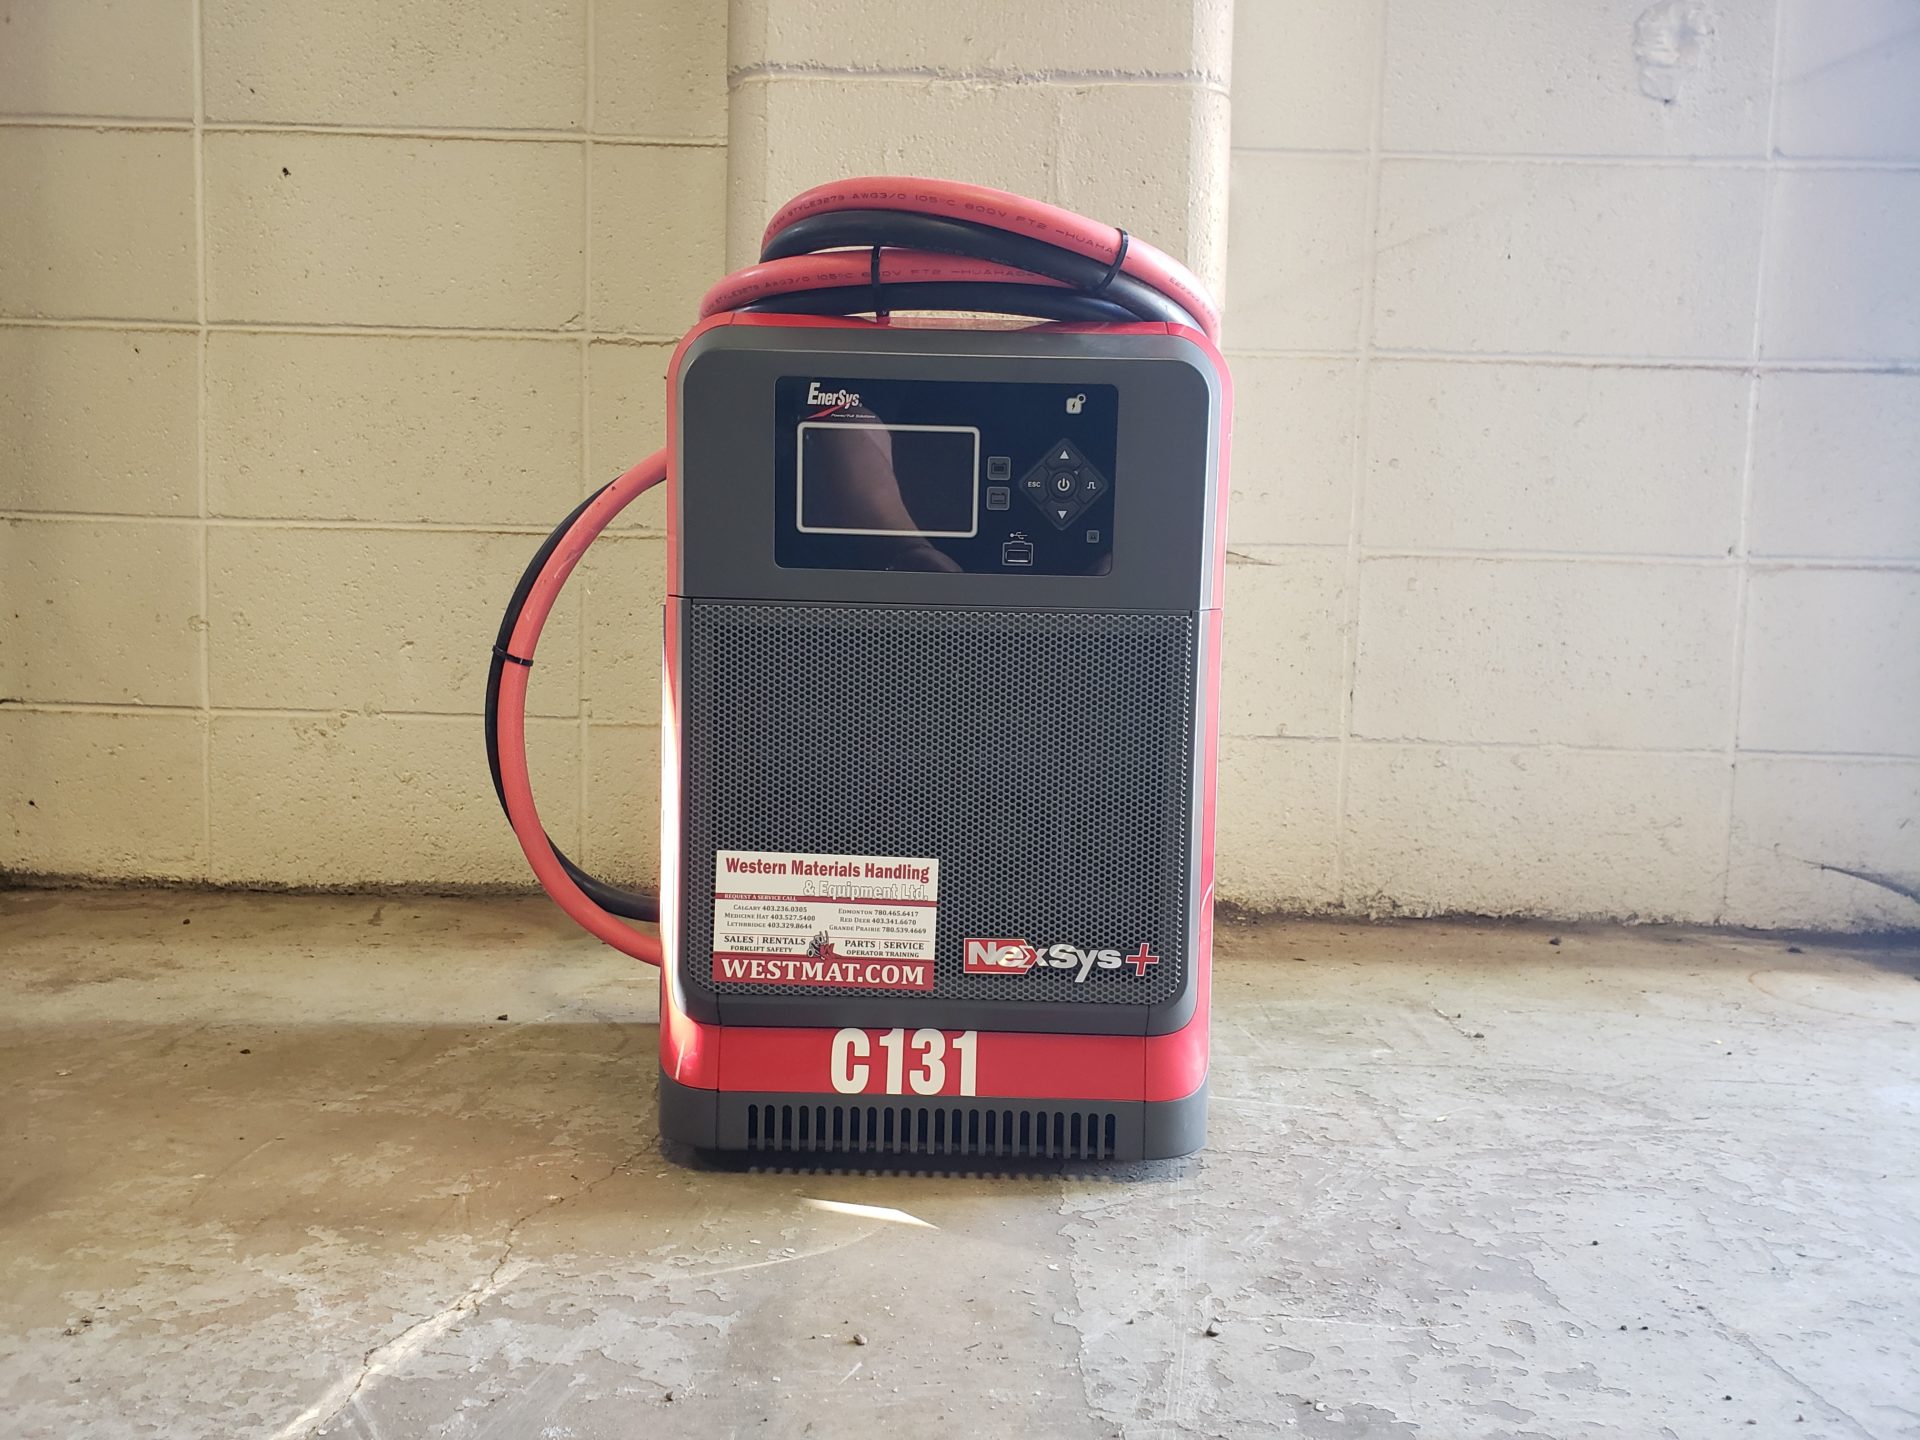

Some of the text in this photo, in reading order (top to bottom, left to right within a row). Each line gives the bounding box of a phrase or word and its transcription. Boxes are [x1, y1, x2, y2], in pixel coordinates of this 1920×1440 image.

[807, 382, 860, 409] EnerSys
[726, 857, 930, 884] Western Materials Handling
[802, 880, 928, 900] & Equipment Ltd.
[724, 935, 806, 946] SALES RENTALS
[844, 940, 924, 950] PARTS SERVICE
[722, 958, 925, 985] WESTMAT.COM
[830, 1027, 978, 1097] C131
